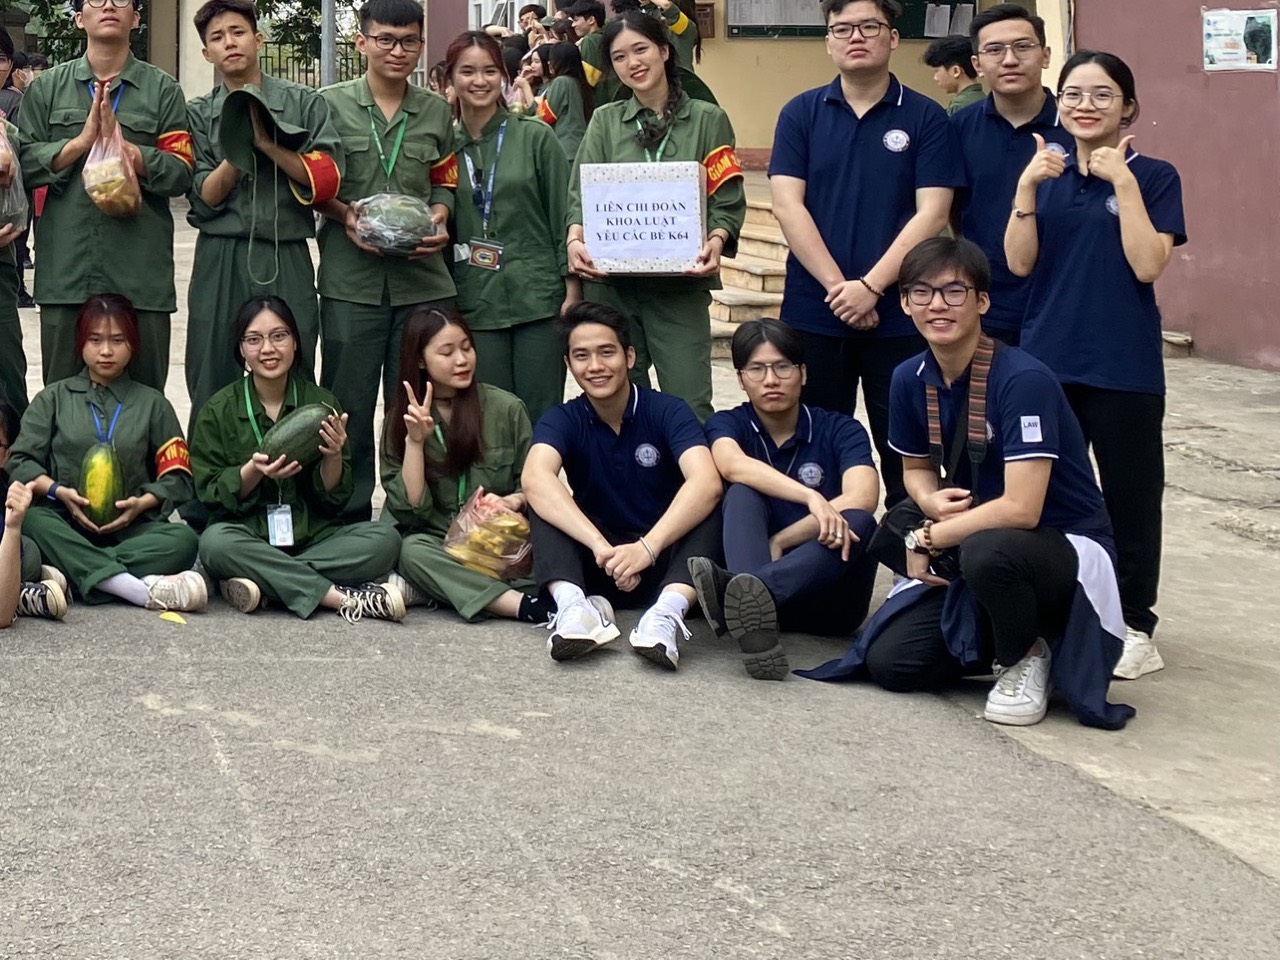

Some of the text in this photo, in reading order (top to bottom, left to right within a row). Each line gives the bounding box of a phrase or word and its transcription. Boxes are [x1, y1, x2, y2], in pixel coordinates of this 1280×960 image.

[596, 200, 687, 212] LIÊN CHI ĐOÀN
[606, 215, 677, 227] KHOA LUẬT
[596, 228, 689, 241] YÊU CÁC BÉ K64
